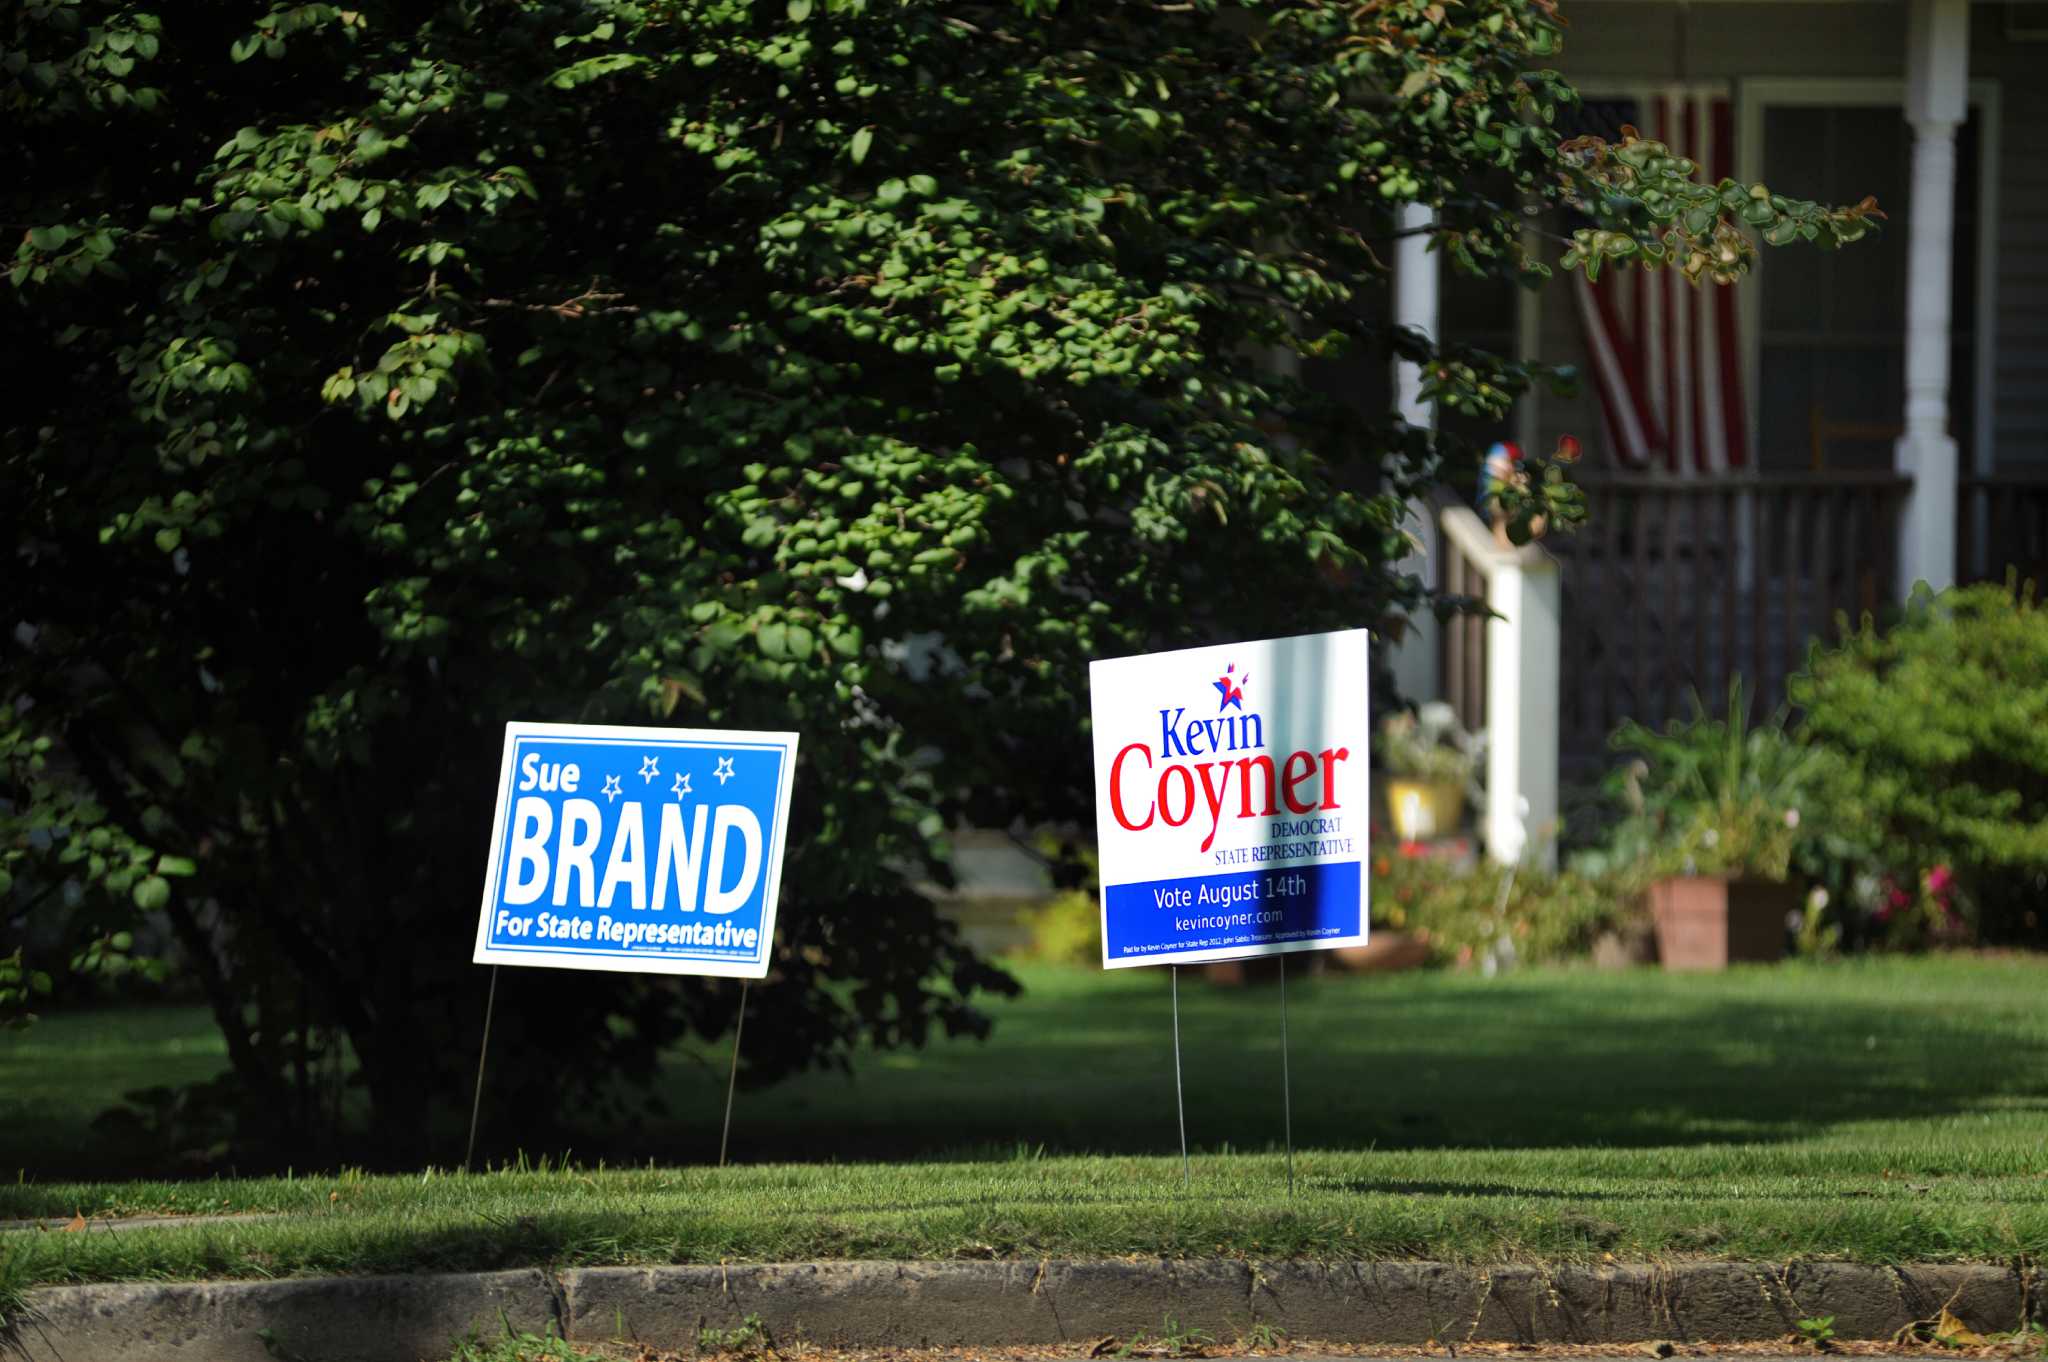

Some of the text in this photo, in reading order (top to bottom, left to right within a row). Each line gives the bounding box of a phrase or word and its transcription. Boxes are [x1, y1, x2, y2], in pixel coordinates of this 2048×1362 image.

[1160, 708, 1264, 758] Kevin
[519, 753, 580, 792] Sue
[1109, 743, 1350, 853] Coyner
[1272, 817, 1343, 838] DEMOCRAT
[503, 797, 762, 914] BRAND
[1215, 839, 1354, 866] STATE REPRESENTATIVE
[1154, 874, 1306, 909] Vote August 14th
[496, 910, 758, 948] For State Representative
[1176, 909, 1283, 932] kevincoyner.com
[1160, 943, 1177, 951] Coyner
[1185, 940, 1198, 948] State
